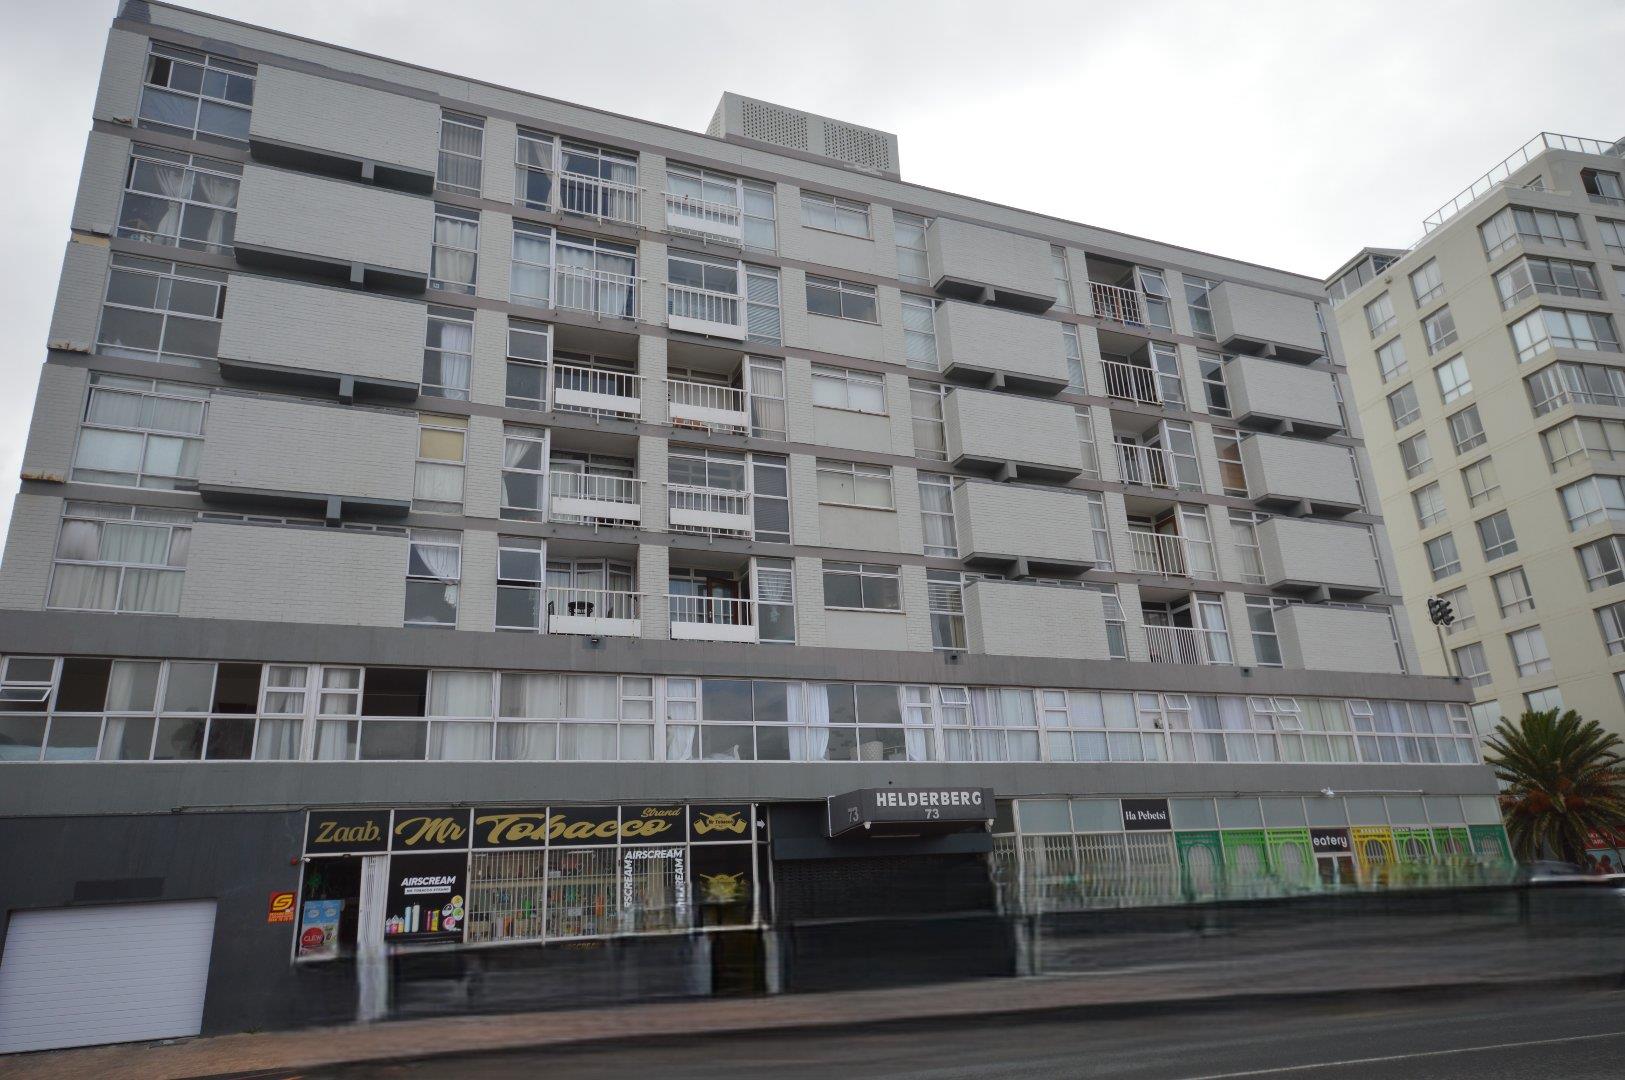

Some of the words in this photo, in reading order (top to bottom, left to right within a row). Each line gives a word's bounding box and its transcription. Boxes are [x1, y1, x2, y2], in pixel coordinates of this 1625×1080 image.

[876, 791, 982, 807] HELDERBERG
[640, 807, 682, 818] Strand
[848, 806, 860, 822] 73
[924, 808, 940, 819] 73
[1125, 811, 1137, 820] Ha
[395, 816, 467, 846] Mr
[475, 813, 672, 844] Tobacco
[1313, 835, 1348, 848] eatery
[625, 849, 683, 860] AIRSCREAM
[401, 876, 457, 887] AIRSCREAM
